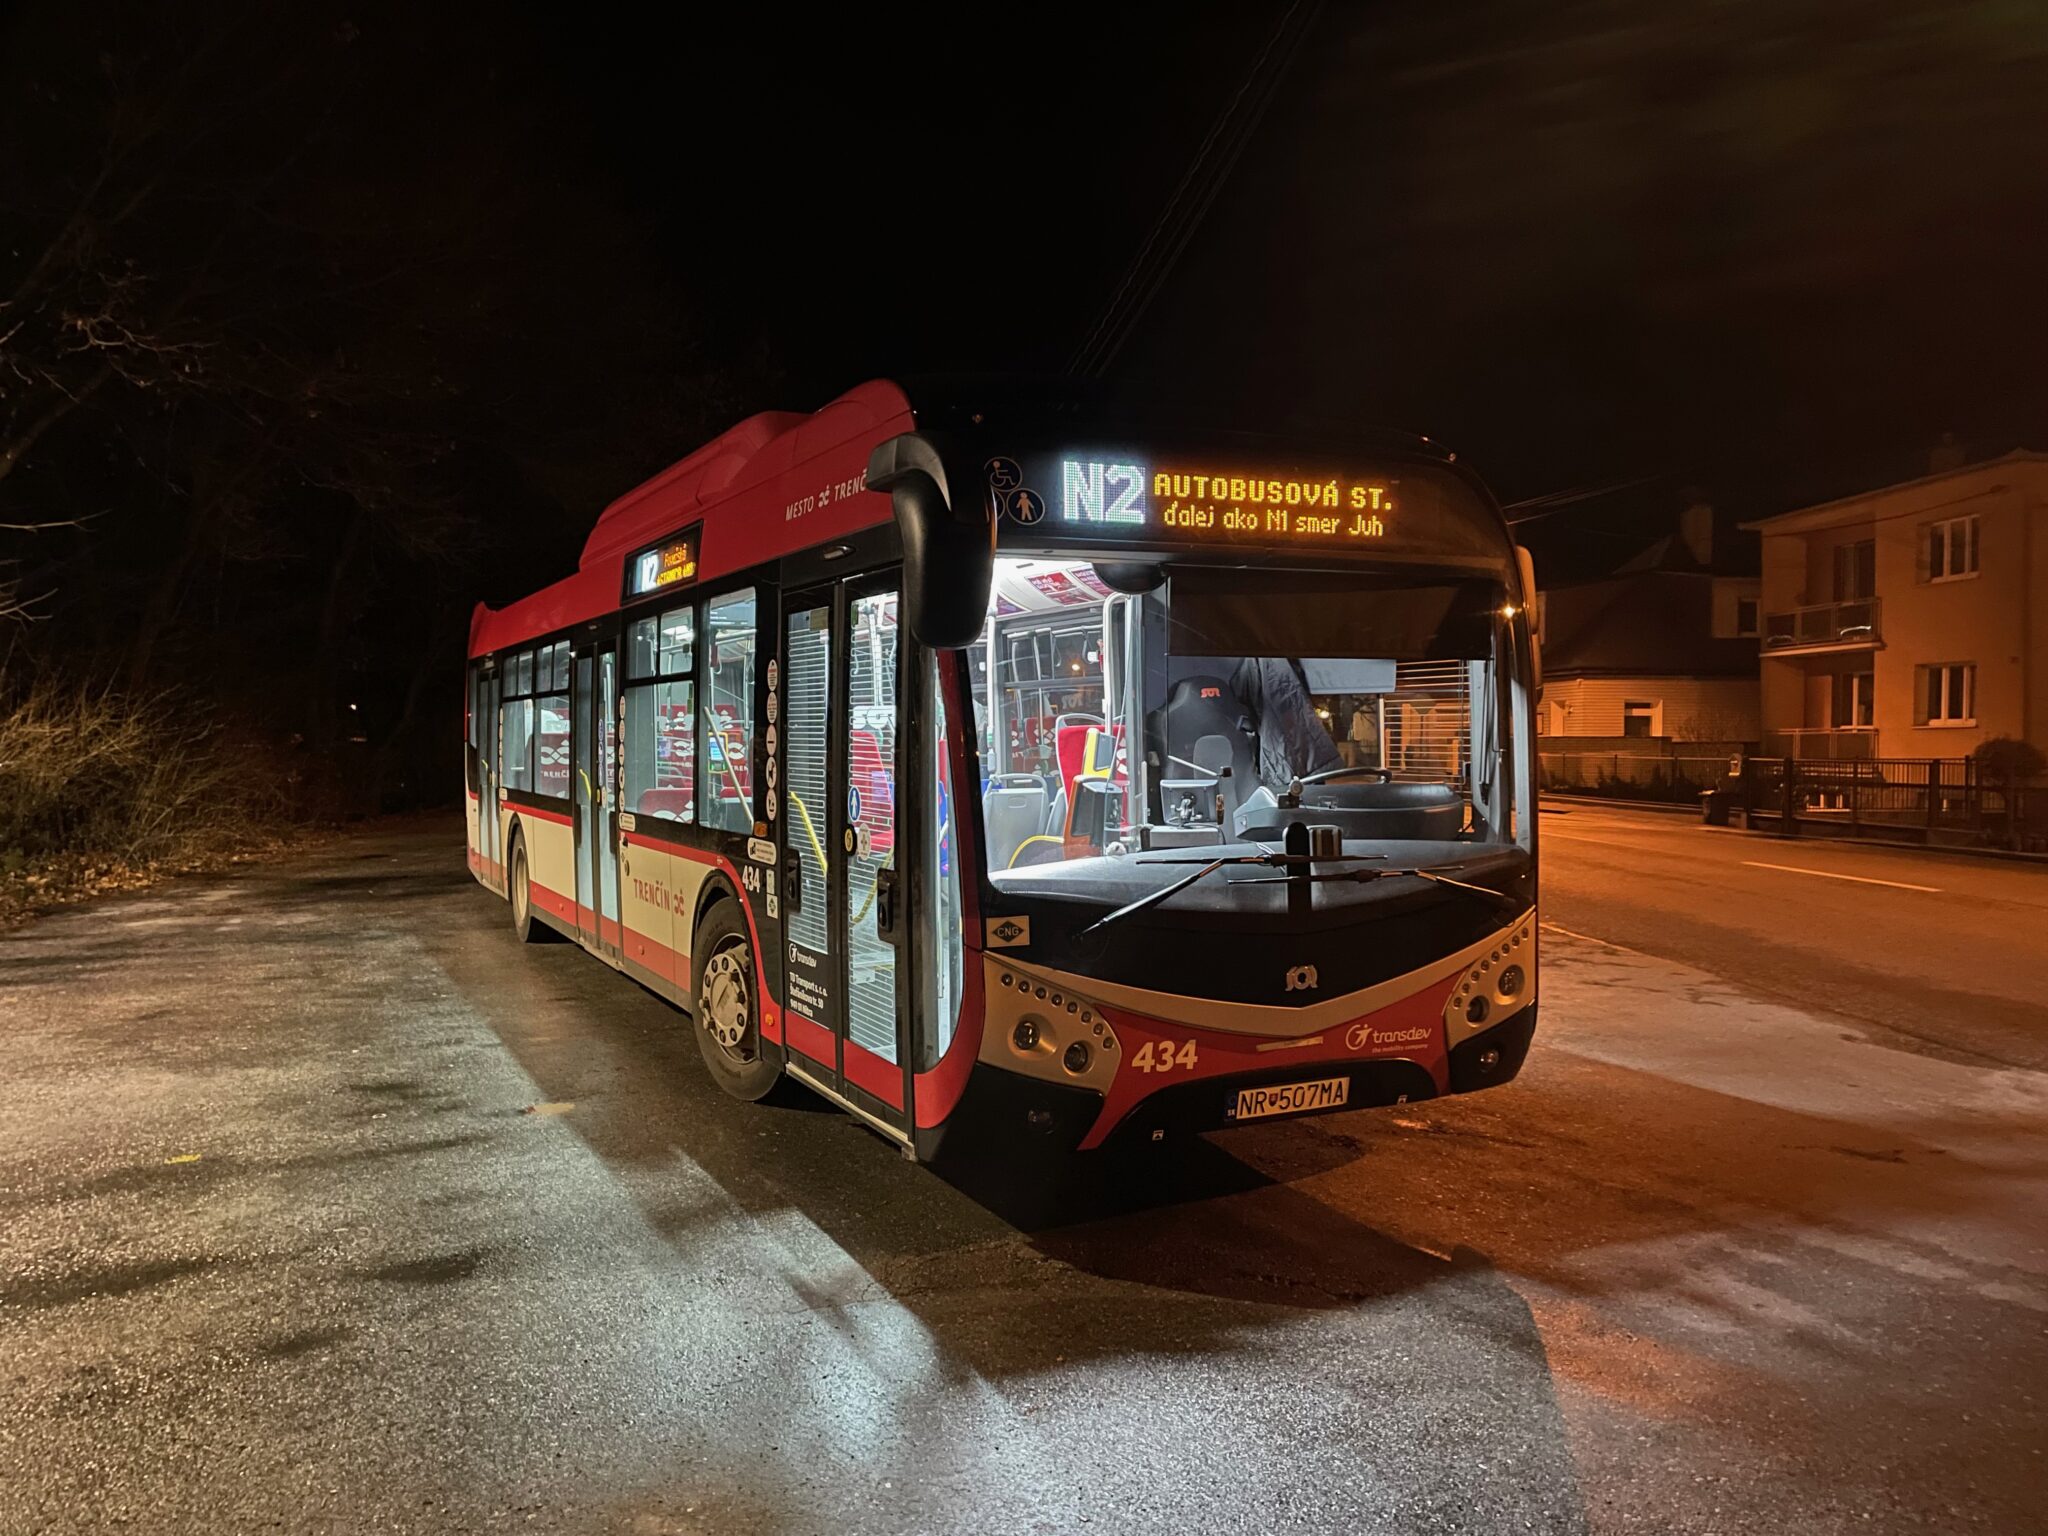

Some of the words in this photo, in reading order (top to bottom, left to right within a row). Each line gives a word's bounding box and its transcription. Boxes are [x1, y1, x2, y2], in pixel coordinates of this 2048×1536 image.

[785, 495, 815, 521] MESTO
[1064, 461, 1146, 524] N2
[1154, 473, 1339, 507] AUTOBUSOVÁ
[1351, 486, 1392, 511] ST.
[1164, 501, 1215, 528] ďalej
[1223, 507, 1259, 530] ako
[1266, 508, 1288, 532] N1
[1295, 515, 1341, 534] smer
[1348, 514, 1384, 537] Juh
[633, 878, 671, 911] TRENČÍN
[742, 864, 760, 893] 434
[997, 926, 1020, 937] CNG
[1372, 1026, 1432, 1044] transdev
[1131, 1039, 1199, 1073] 434
